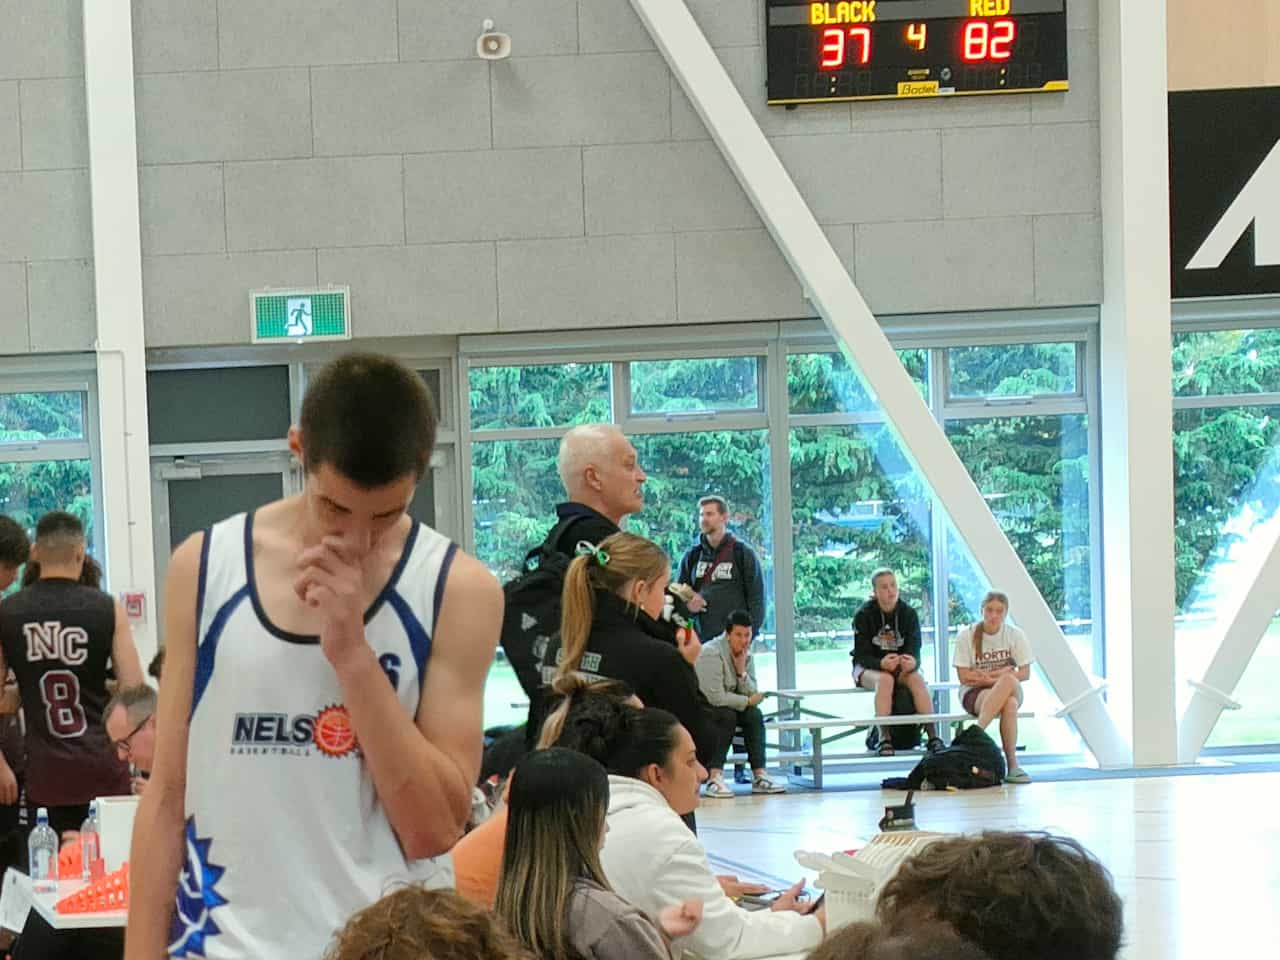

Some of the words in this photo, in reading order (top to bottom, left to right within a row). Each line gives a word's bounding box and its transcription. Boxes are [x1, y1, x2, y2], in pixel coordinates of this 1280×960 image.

[811, 0, 876, 25] BLACK
[970, 0, 1010, 17] RED
[821, 27, 871, 67] 37
[907, 23, 927, 50] 4
[964, 20, 1014, 60] 82
[23, 620, 88, 665] NC
[39, 669, 88, 738] 8
